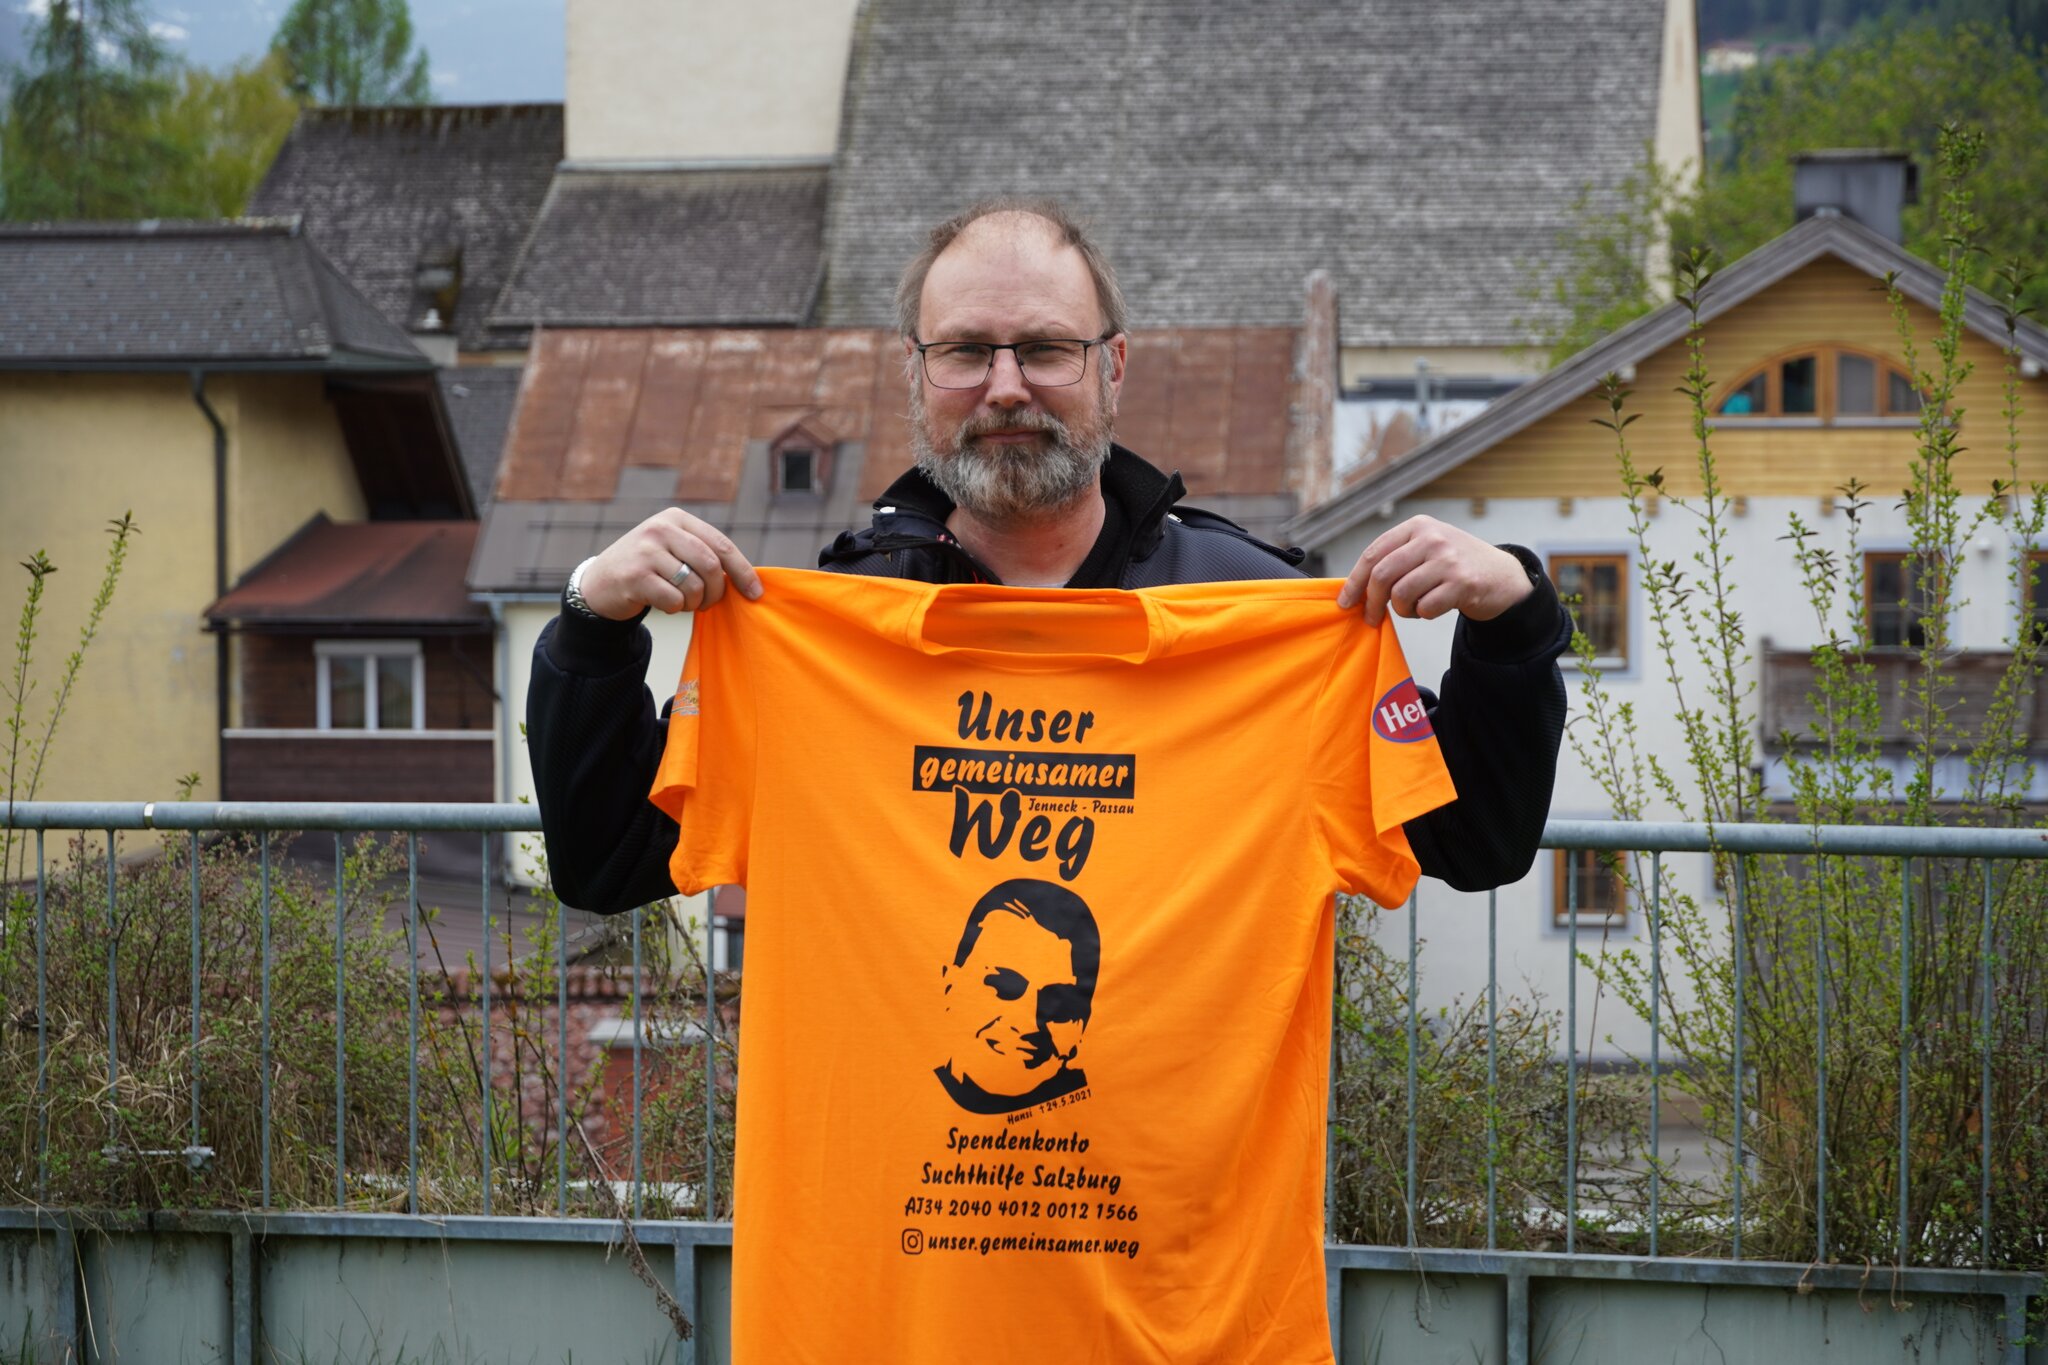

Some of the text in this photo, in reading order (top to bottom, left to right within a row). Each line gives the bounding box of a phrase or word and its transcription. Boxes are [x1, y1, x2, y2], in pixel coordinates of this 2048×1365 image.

[957, 690, 1095, 744] Unser
[920, 753, 1129, 789] gemeinsamer
[1093, 799, 1135, 815] Passau
[949, 786, 1095, 882] Weg
[1007, 1108, 1033, 1125] Hansi
[946, 1126, 1090, 1155] Spendenkonto
[921, 1161, 1122, 1196] Suchthilfe Salzburg
[948, 1199, 992, 1217] 2040
[997, 1200, 1041, 1218] 4012
[1046, 1201, 1090, 1220] 0012
[1096, 1202, 1138, 1222] 1566
[928, 1231, 1140, 1260] unser.gemeinsamer.weg
